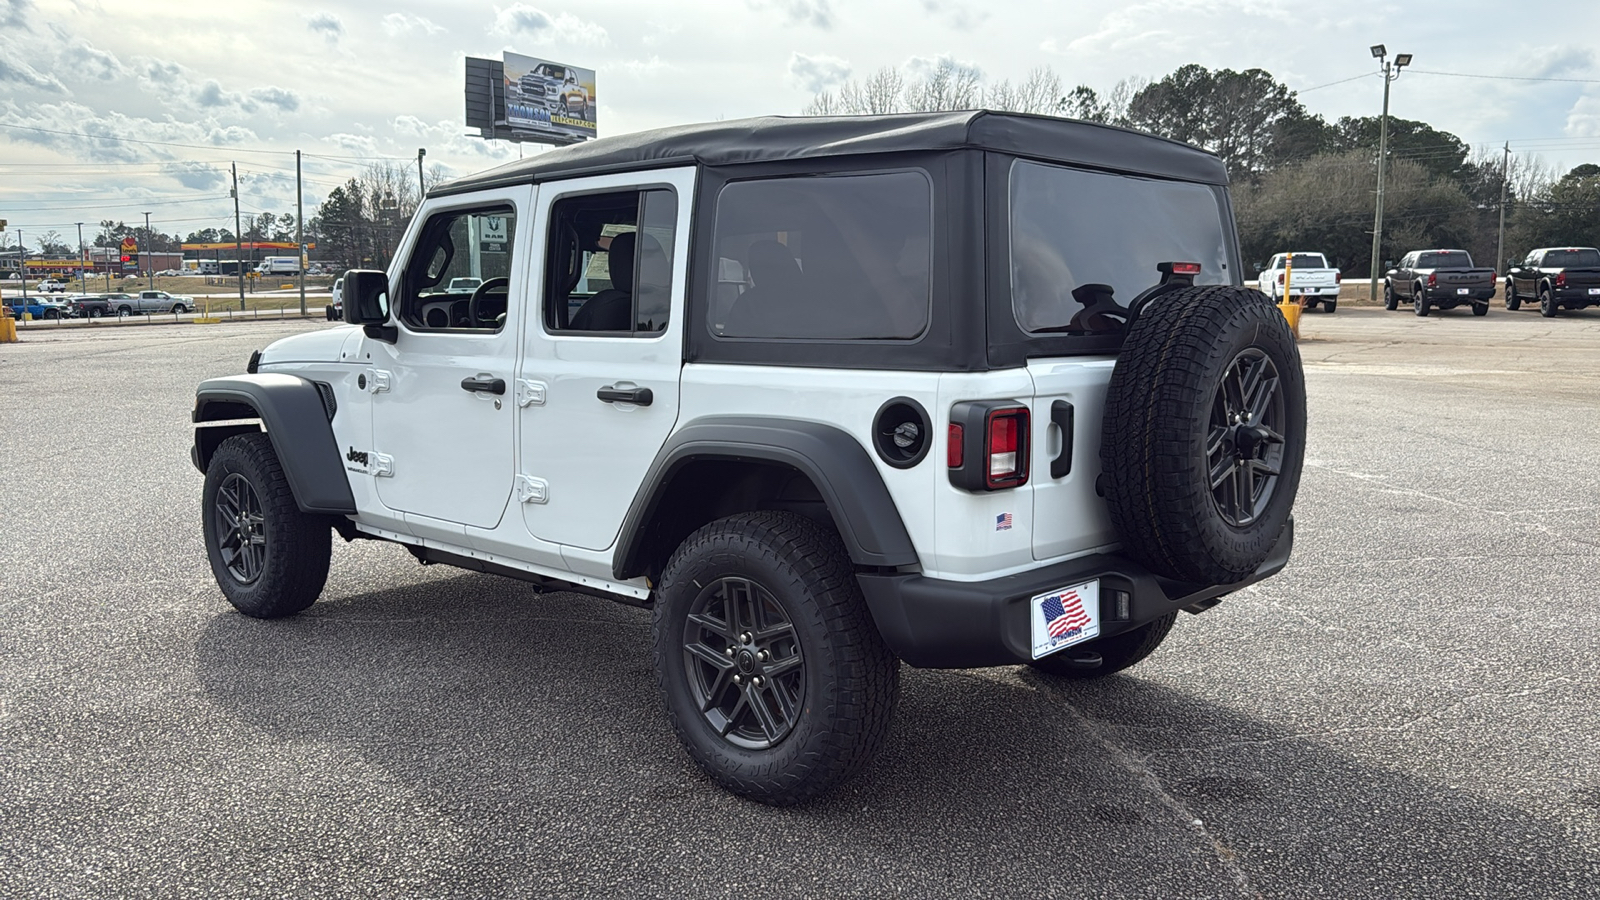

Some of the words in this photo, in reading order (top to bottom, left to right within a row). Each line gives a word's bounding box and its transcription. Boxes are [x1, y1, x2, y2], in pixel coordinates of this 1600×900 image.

[508, 104, 551, 122] THOMSON
[346, 445, 369, 468] Jeep
[1057, 627, 1082, 642] THOMSON
